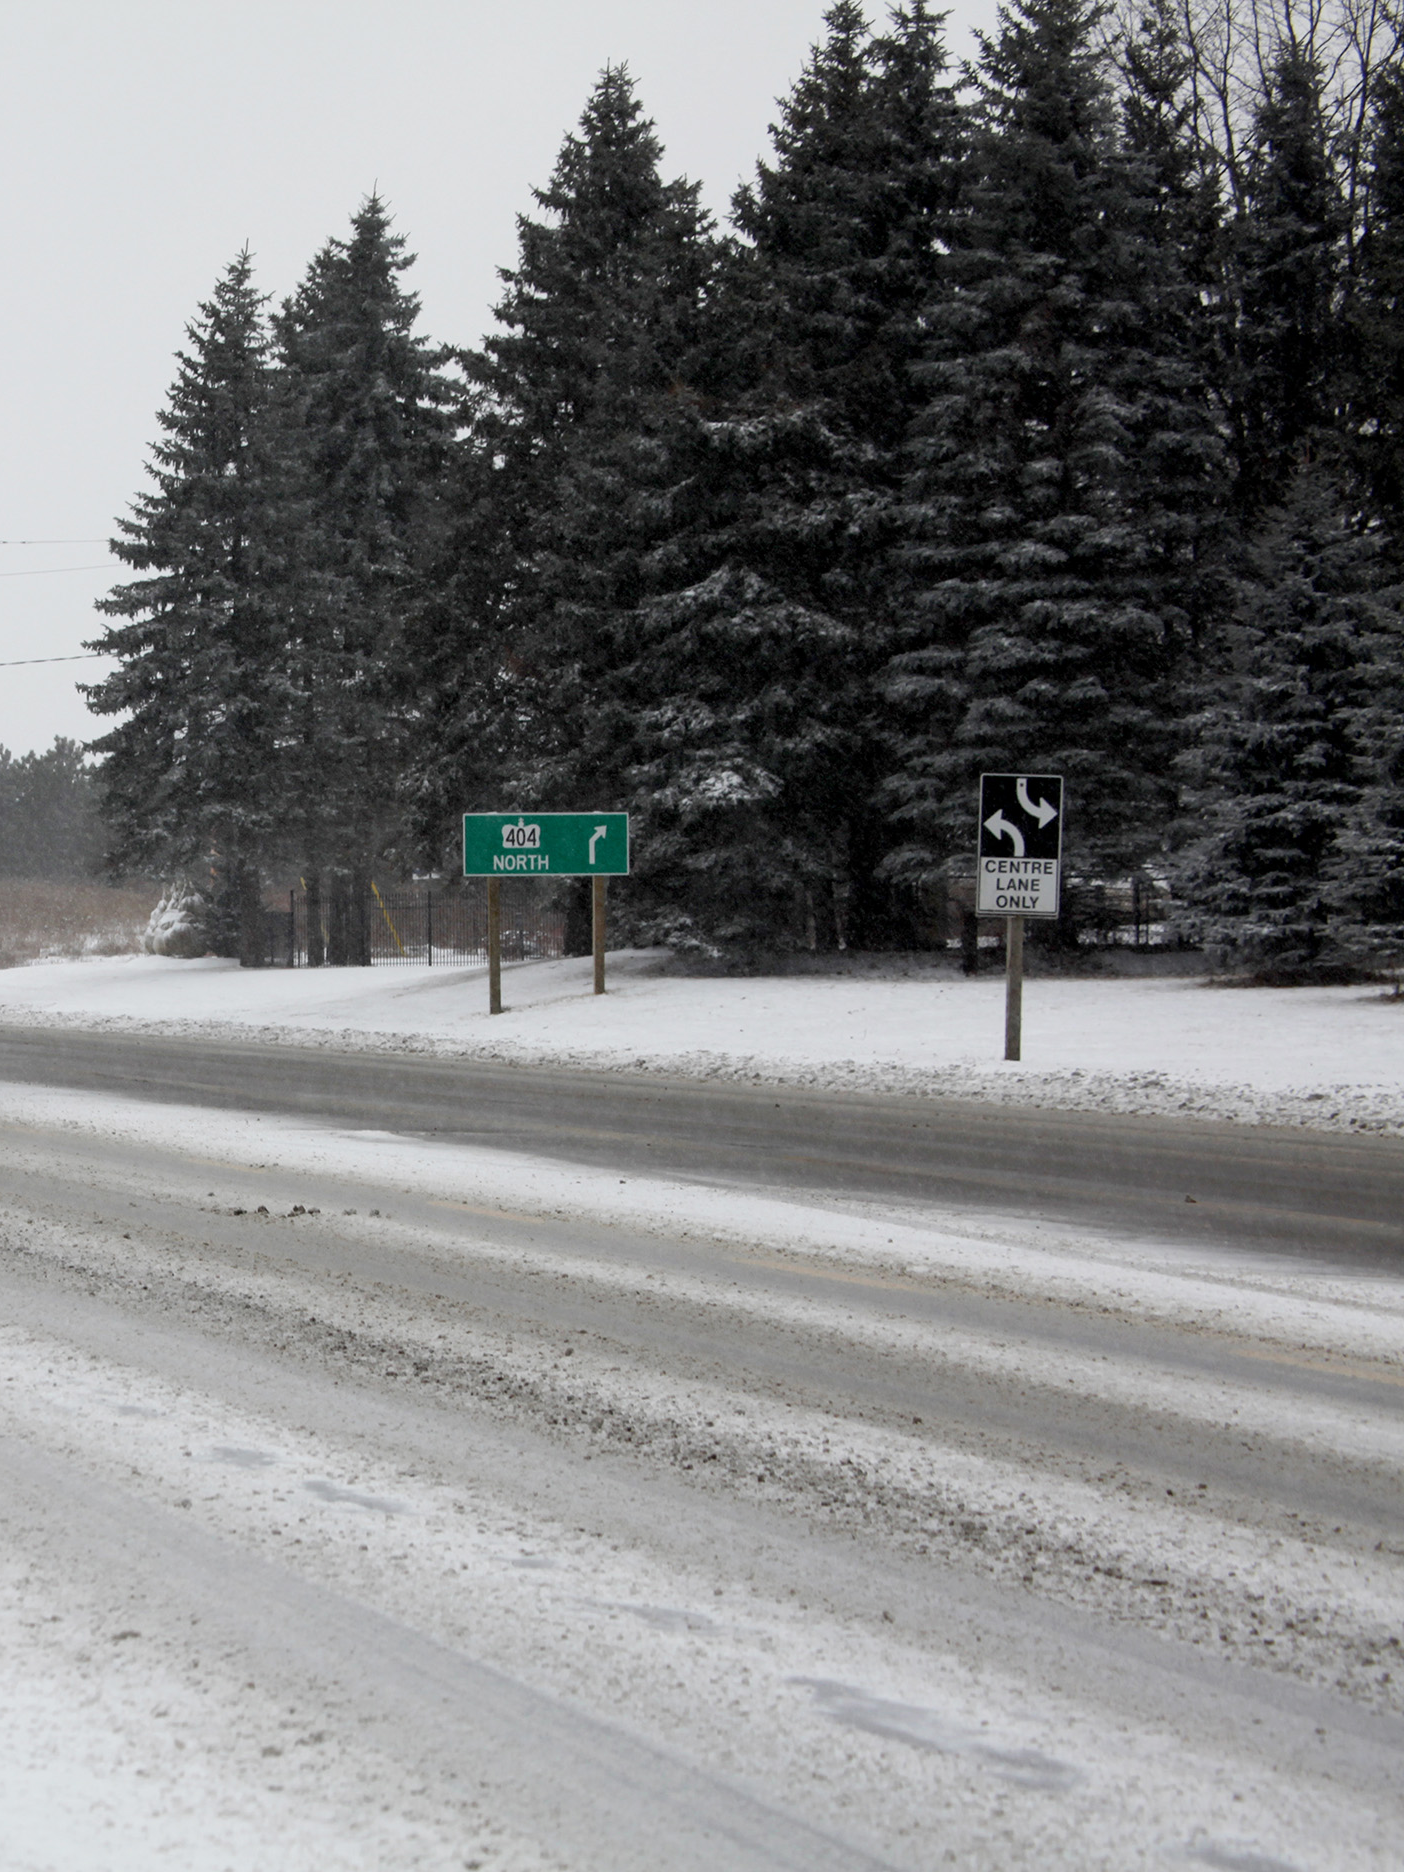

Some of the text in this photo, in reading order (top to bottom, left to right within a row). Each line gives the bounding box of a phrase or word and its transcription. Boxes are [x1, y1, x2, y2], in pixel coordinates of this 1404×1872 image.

[505, 828, 537, 846] 404
[493, 855, 549, 870] NORTH
[984, 860, 1053, 874] CENTRE
[996, 878, 1040, 891] LANE
[996, 895, 1039, 909] ONLY
